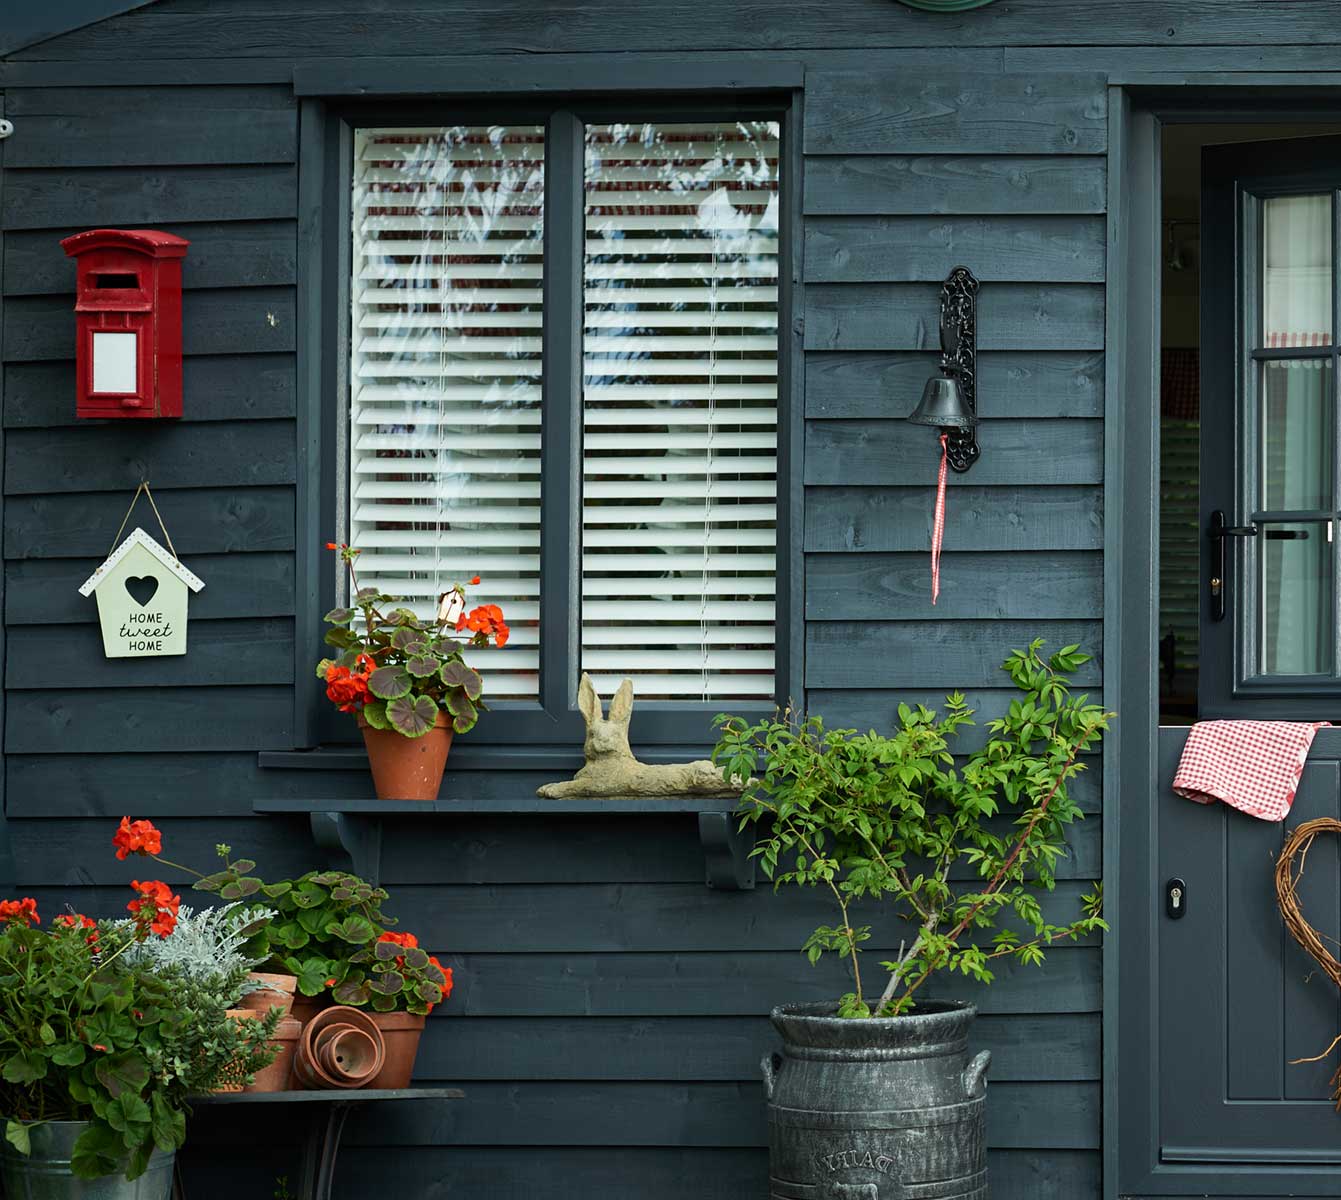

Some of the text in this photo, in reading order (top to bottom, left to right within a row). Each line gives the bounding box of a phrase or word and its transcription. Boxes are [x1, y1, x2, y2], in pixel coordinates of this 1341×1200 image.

[129, 613, 162, 623] HOME
[120, 622, 173, 637] tweet
[129, 641, 162, 651] HOME
